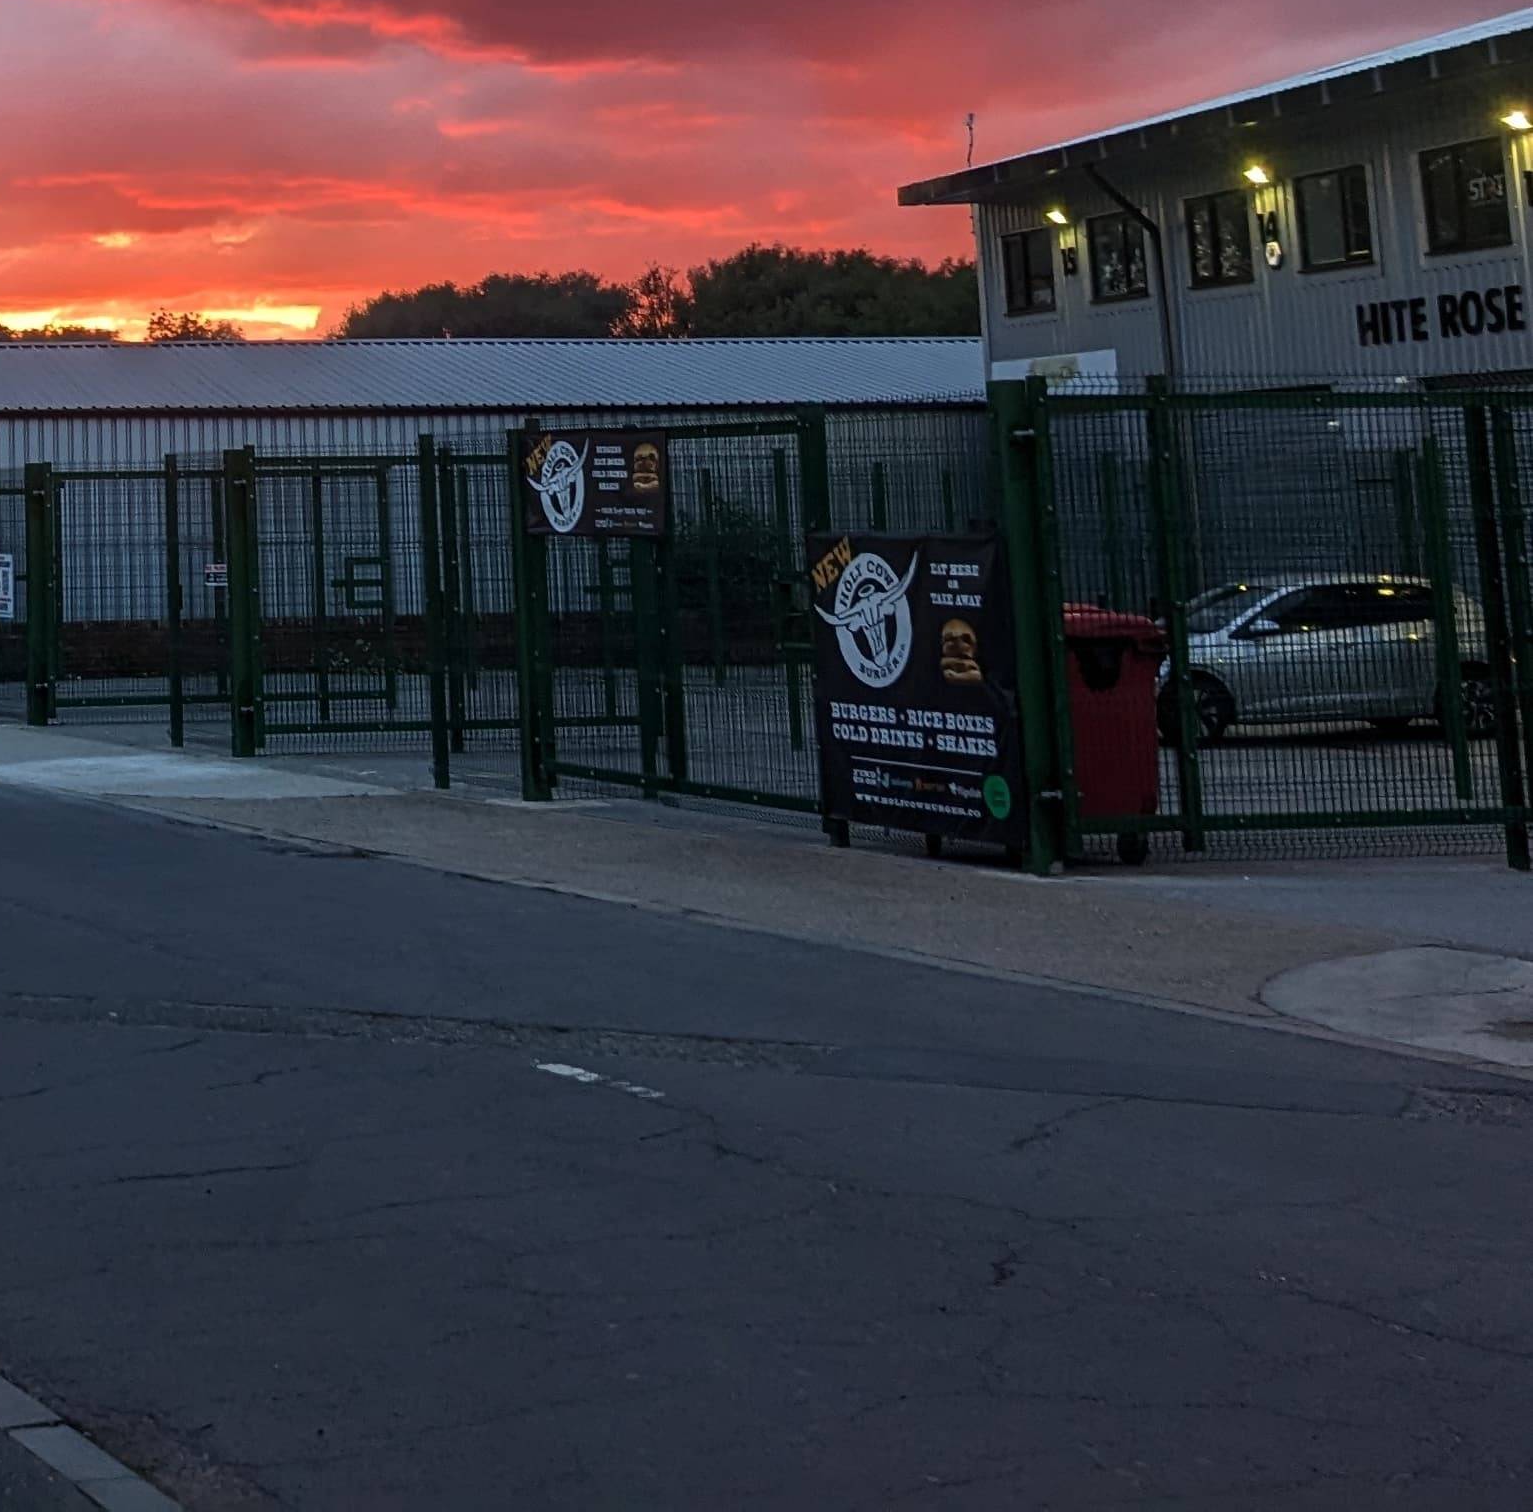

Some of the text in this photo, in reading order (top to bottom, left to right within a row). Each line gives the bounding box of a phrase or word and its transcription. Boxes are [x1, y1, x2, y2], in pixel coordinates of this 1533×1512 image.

[1357, 285, 1526, 347] HITE ROSE
[811, 535, 852, 593] NEW
[866, 560, 895, 588] COW
[955, 593, 983, 608] AWAY
[830, 701, 996, 735] BURGERS RICE BOXES
[832, 722, 999, 758] COLD DRINKS SHAKES
